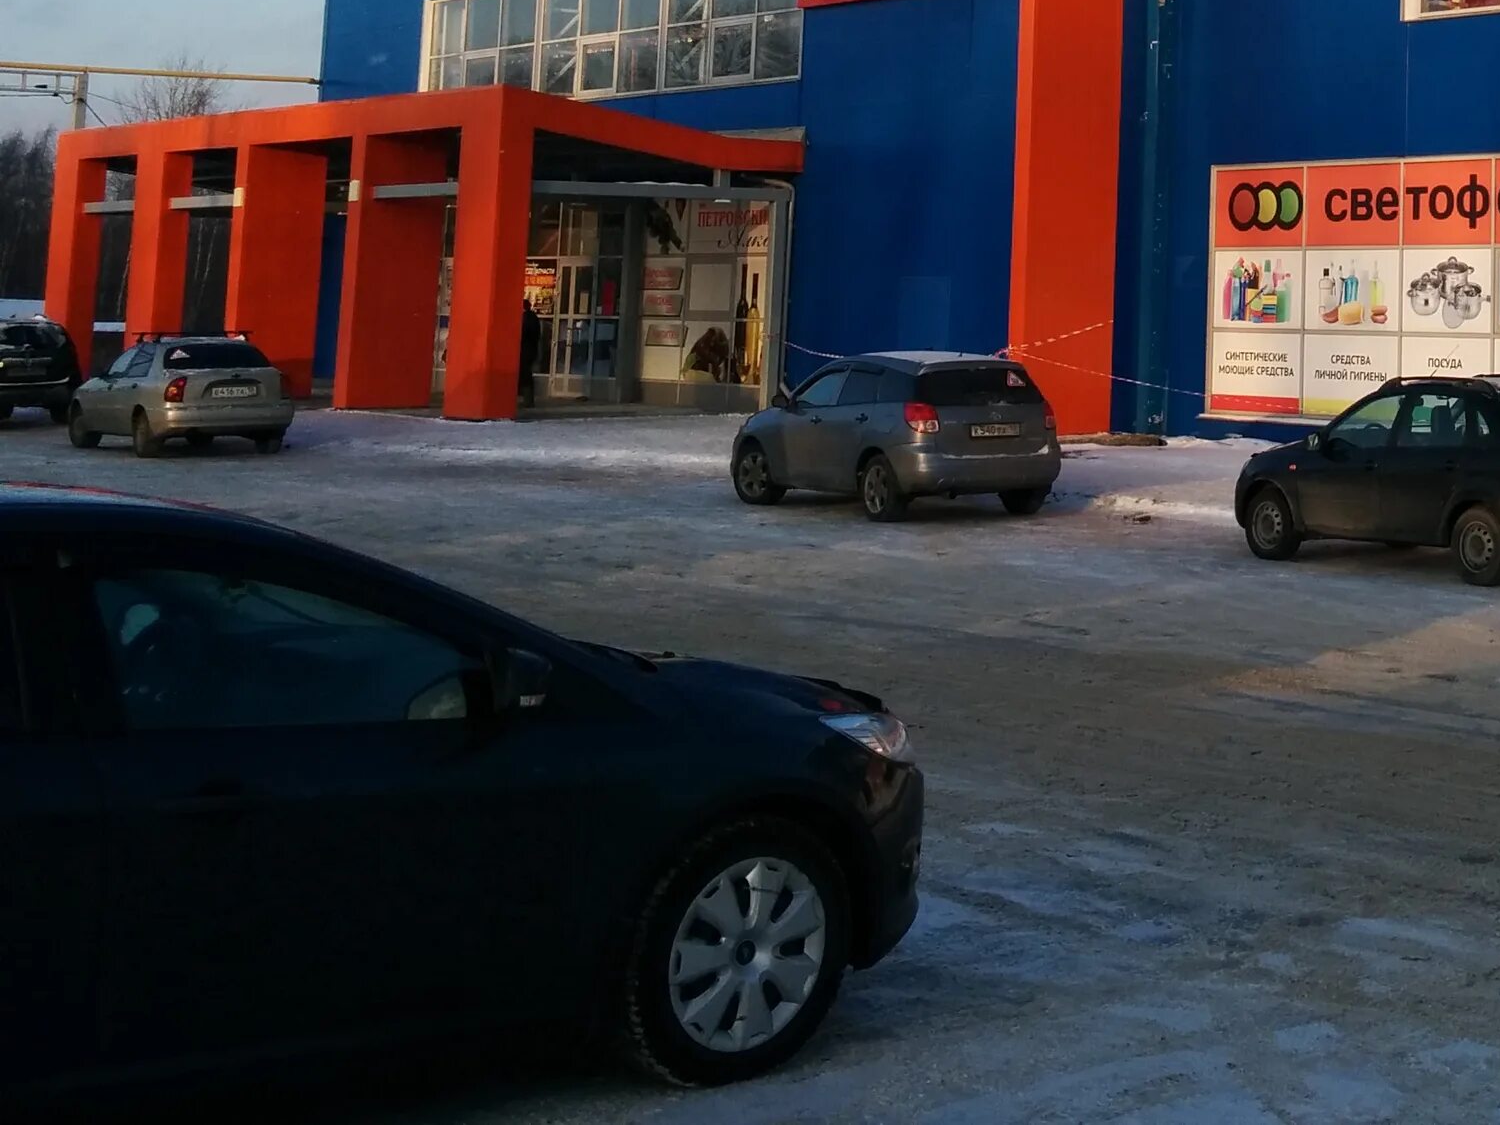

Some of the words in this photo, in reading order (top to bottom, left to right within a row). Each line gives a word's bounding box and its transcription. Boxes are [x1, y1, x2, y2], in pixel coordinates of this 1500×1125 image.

[1225, 351, 1288, 363] СИНТЕТИЧЕСКИЕ
[1330, 355, 1371, 366] СРЕДСТВА
[1428, 358, 1463, 369] ПОСУДА
[1218, 365, 1254, 376] МОЮЩИЕ
[1256, 366, 1294, 377] СРЕДСТВА
[1314, 368, 1348, 381] ЛИЧНОЙ
[1349, 370, 1387, 382] ГИГИЕНЫ
